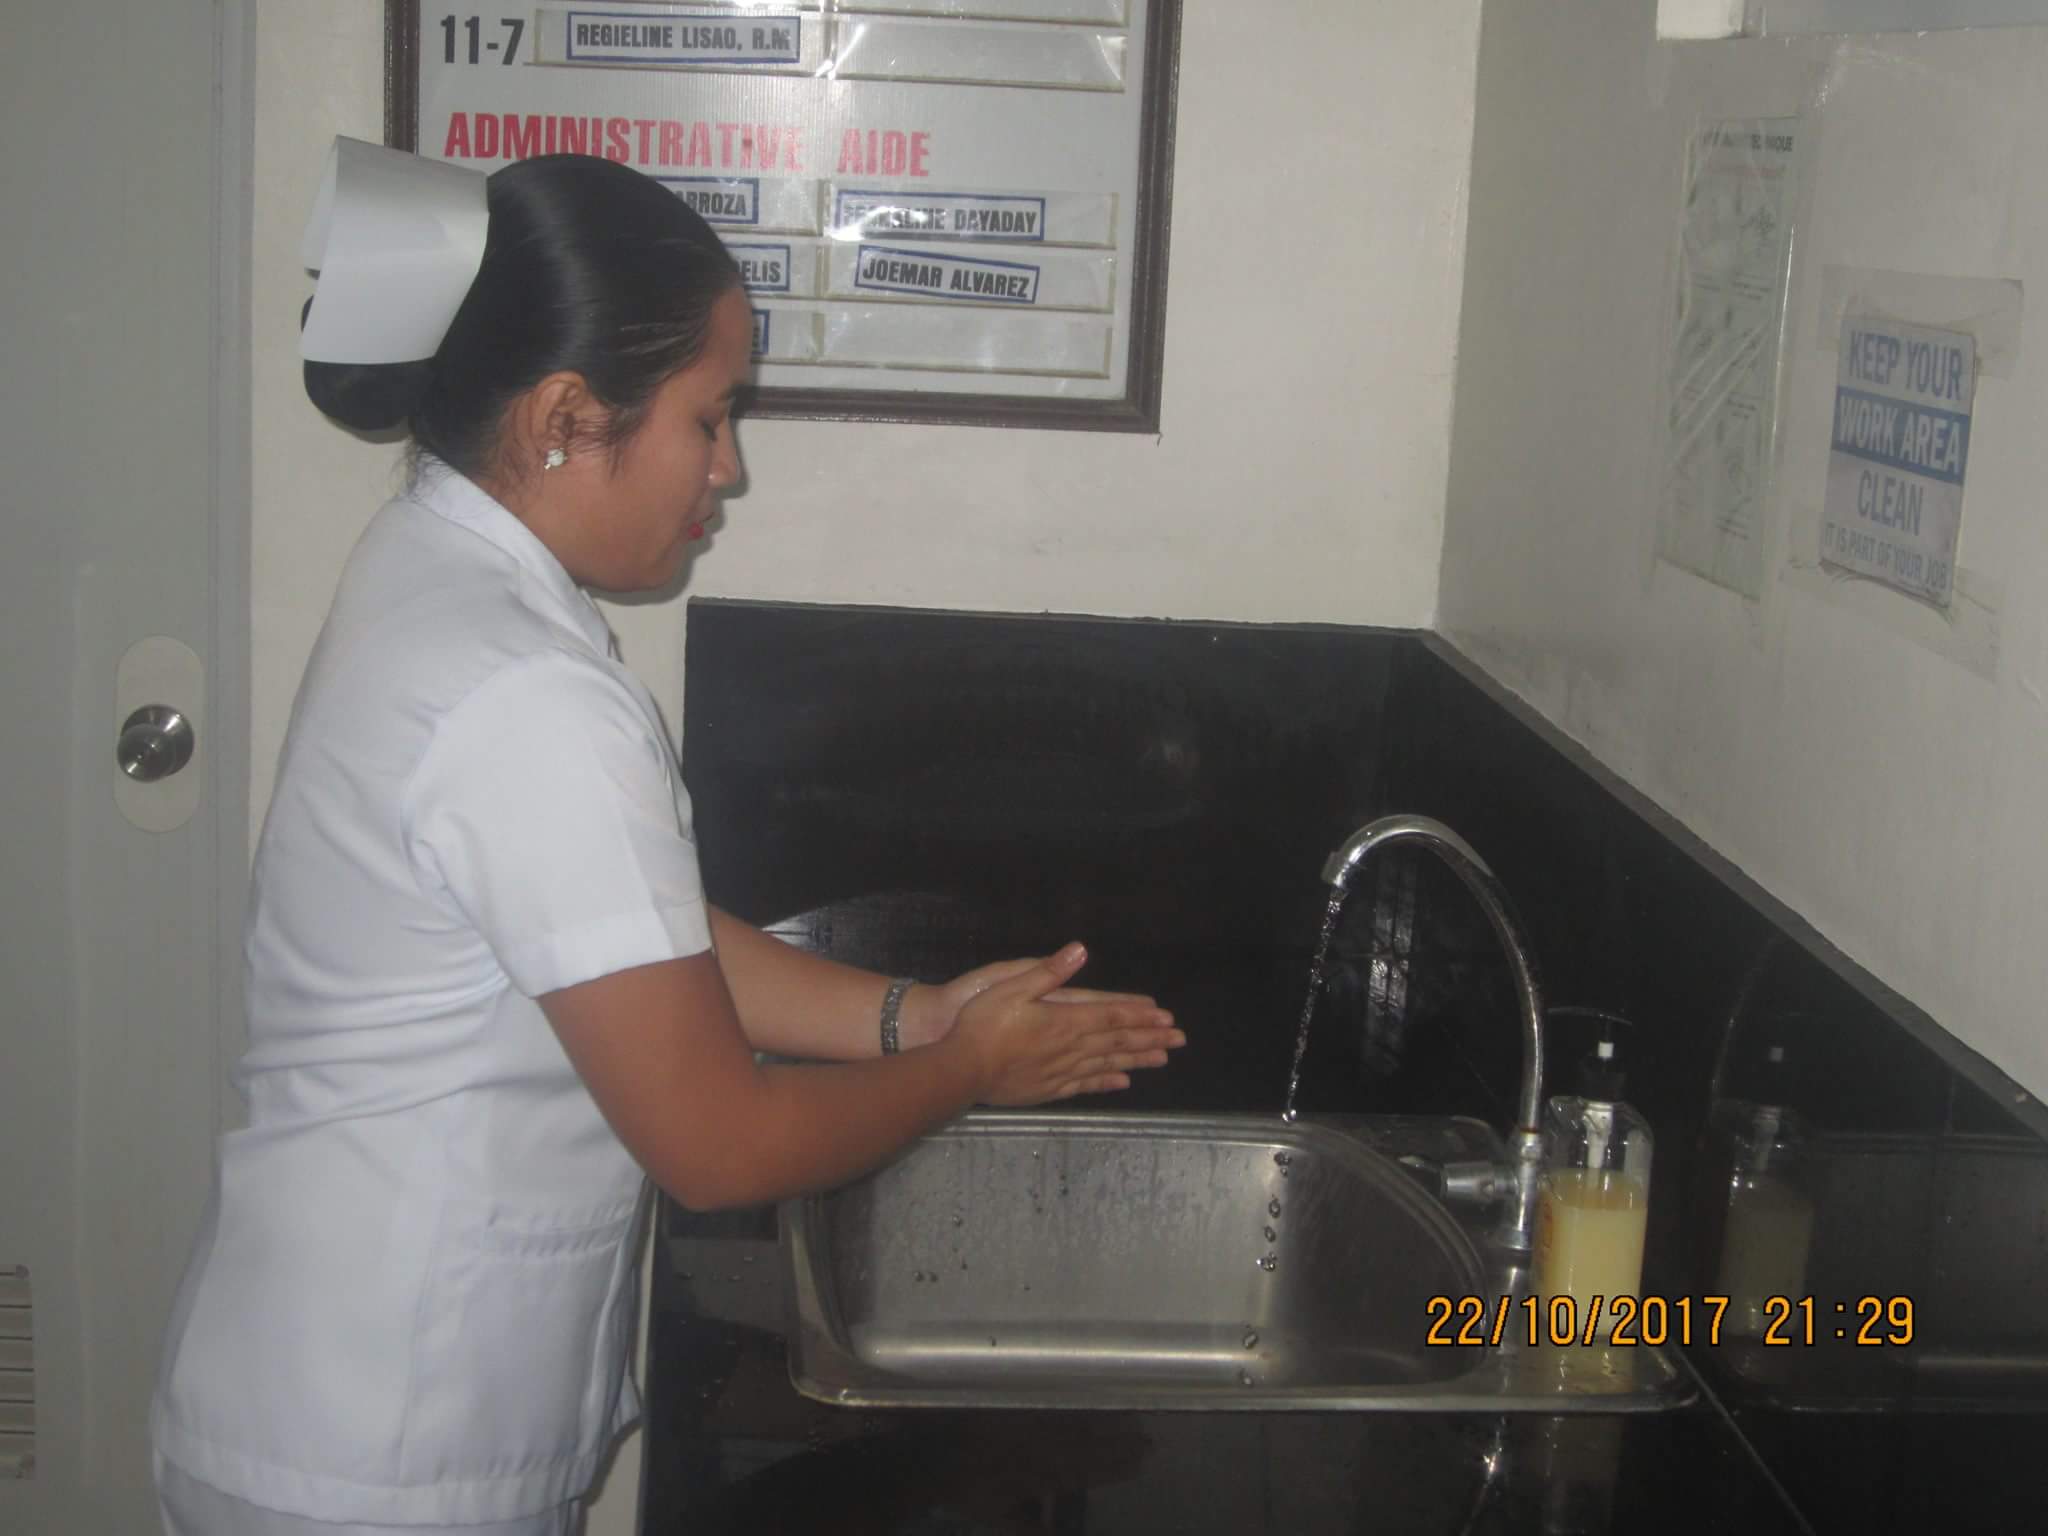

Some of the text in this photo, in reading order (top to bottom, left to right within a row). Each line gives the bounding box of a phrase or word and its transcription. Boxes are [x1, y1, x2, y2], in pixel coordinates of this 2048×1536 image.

[440, 14, 525, 66] 11-7
[576, 24, 673, 50] REGIELINE
[444, 111, 931, 177] ADMINISTRATIVE AIDE
[954, 209, 1037, 233] DAYADAY
[862, 258, 1030, 298] JOEMAR ALVAREZ
[1849, 329, 1962, 402] KEEP YOUR
[1838, 395, 1961, 476] WORK AREA
[1857, 469, 1924, 537] CLEAN
[1849, 531, 1876, 562] PART
[1893, 548, 1923, 580] YOUR
[1926, 557, 1948, 590] JOB
